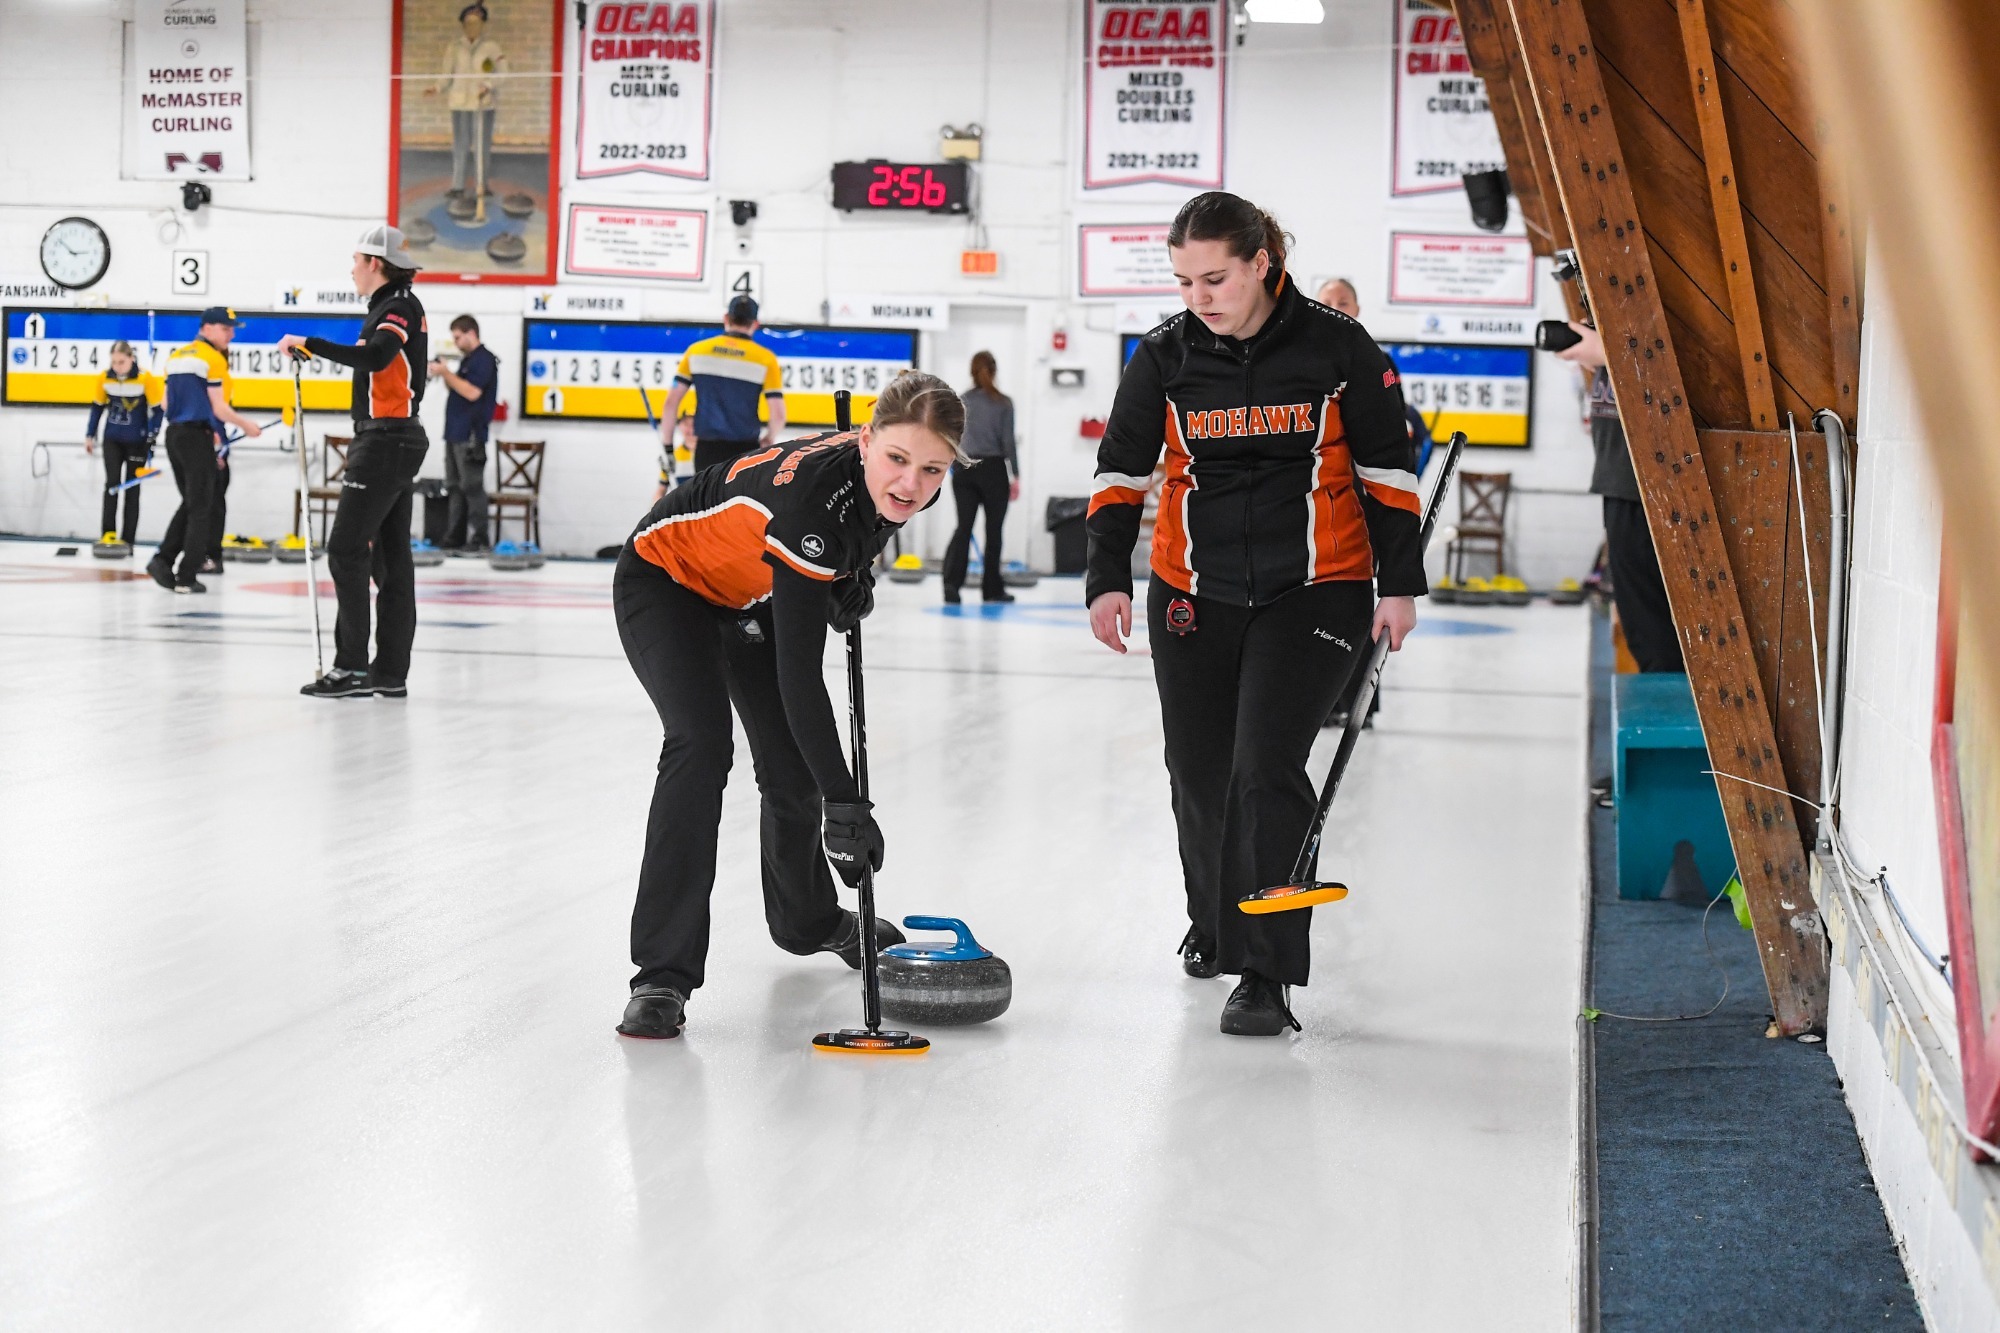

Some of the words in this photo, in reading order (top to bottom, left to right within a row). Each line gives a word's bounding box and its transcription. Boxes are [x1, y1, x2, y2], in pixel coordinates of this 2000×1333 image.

[164, 15, 217, 26] CURLING
[596, 4, 698, 35] OCAA
[1102, 8, 1210, 39] OCAA
[591, 38, 701, 62] CHAMPIONS
[1098, 44, 1214, 68] CHAMPIONS
[150, 68, 204, 83] HOME
[209, 67, 234, 83] OF
[620, 65, 670, 80] MEN'S
[1128, 72, 1183, 87] MIXED
[610, 82, 679, 98] CURLING
[1116, 90, 1194, 105] DOUBLES
[142, 92, 243, 108] McMASTER
[1118, 108, 1193, 123] CURLING
[152, 117, 233, 132] CURLING
[599, 143, 687, 159] 2022-2023
[1107, 153, 1200, 169] 2021-2022
[868, 166, 946, 207] 2:56
[181, 258, 200, 286] 3
[732, 270, 753, 295] 4
[0, 286, 67, 299] FANSHAWE
[566, 297, 625, 311] HUMBER
[871, 304, 935, 319] MOHAWK
[1307, 301, 1356, 325] DYNASTY
[30, 319, 38, 338] 1
[1462, 320, 1524, 335] NIAGARA
[32, 345, 38, 367] 1
[50, 345, 59, 369] 2
[69, 345, 78, 369] 3
[89, 346, 98, 368] 4
[248, 350, 262, 373] 12
[268, 350, 282, 374] 13
[551, 358, 558, 380] 1
[570, 358, 580, 382] 2
[590, 358, 600, 382] 3
[610, 359, 621, 382] 4
[632, 359, 642, 383] 5
[653, 360, 663, 384] 6
[799, 364, 815, 390] 13
[820, 365, 835, 389] 14
[842, 365, 858, 390] 15
[863, 366, 879, 391] 16
[548, 390, 557, 411] 1
[1454, 383, 1471, 407] 15
[1476, 383, 1492, 408] 16
[1187, 402, 1315, 440] MOHAWK
[825, 480, 853, 511] DYNASTY
